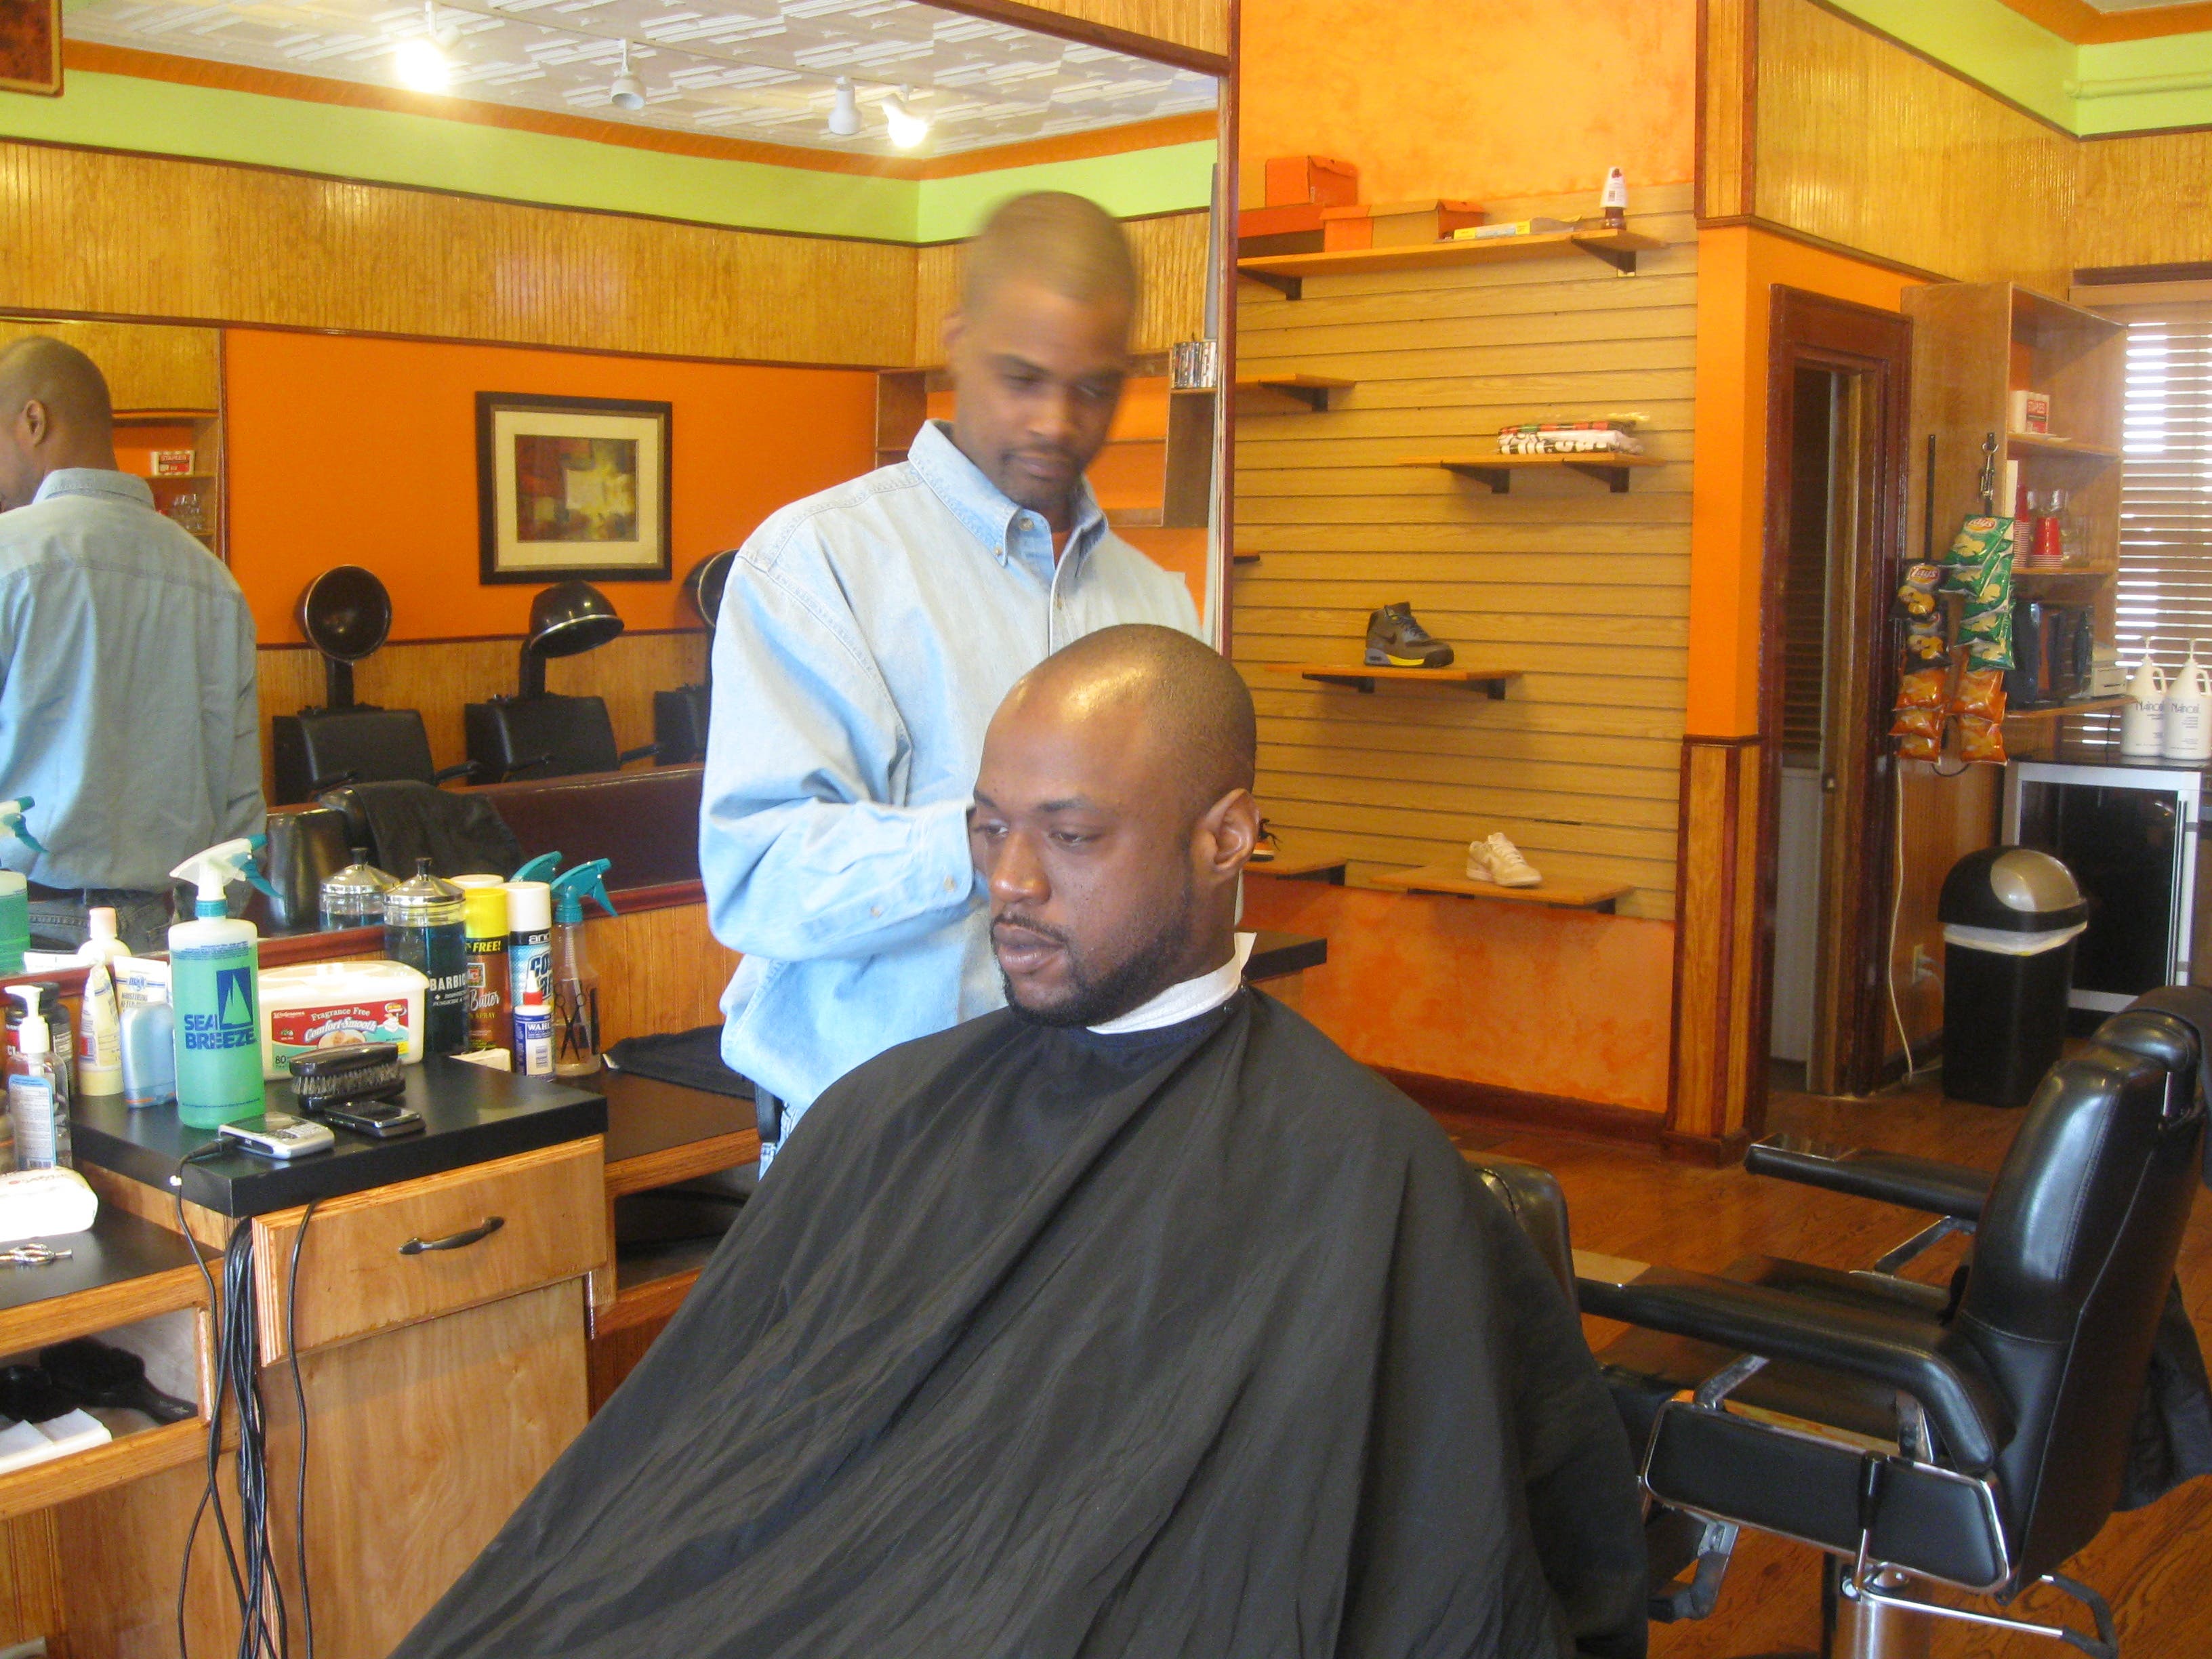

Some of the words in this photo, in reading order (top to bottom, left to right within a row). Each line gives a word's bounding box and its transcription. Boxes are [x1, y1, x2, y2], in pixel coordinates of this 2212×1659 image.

[472, 941, 501, 952] FREE!
[470, 989, 500, 1011] Butter
[310, 1008, 351, 1021] Fragrance
[353, 1007, 371, 1017] Free
[184, 1014, 218, 1031] SEA
[528, 1022, 550, 1031] WAHL
[186, 1027, 257, 1050] BREEZE
[275, 1055, 287, 1065] 80
